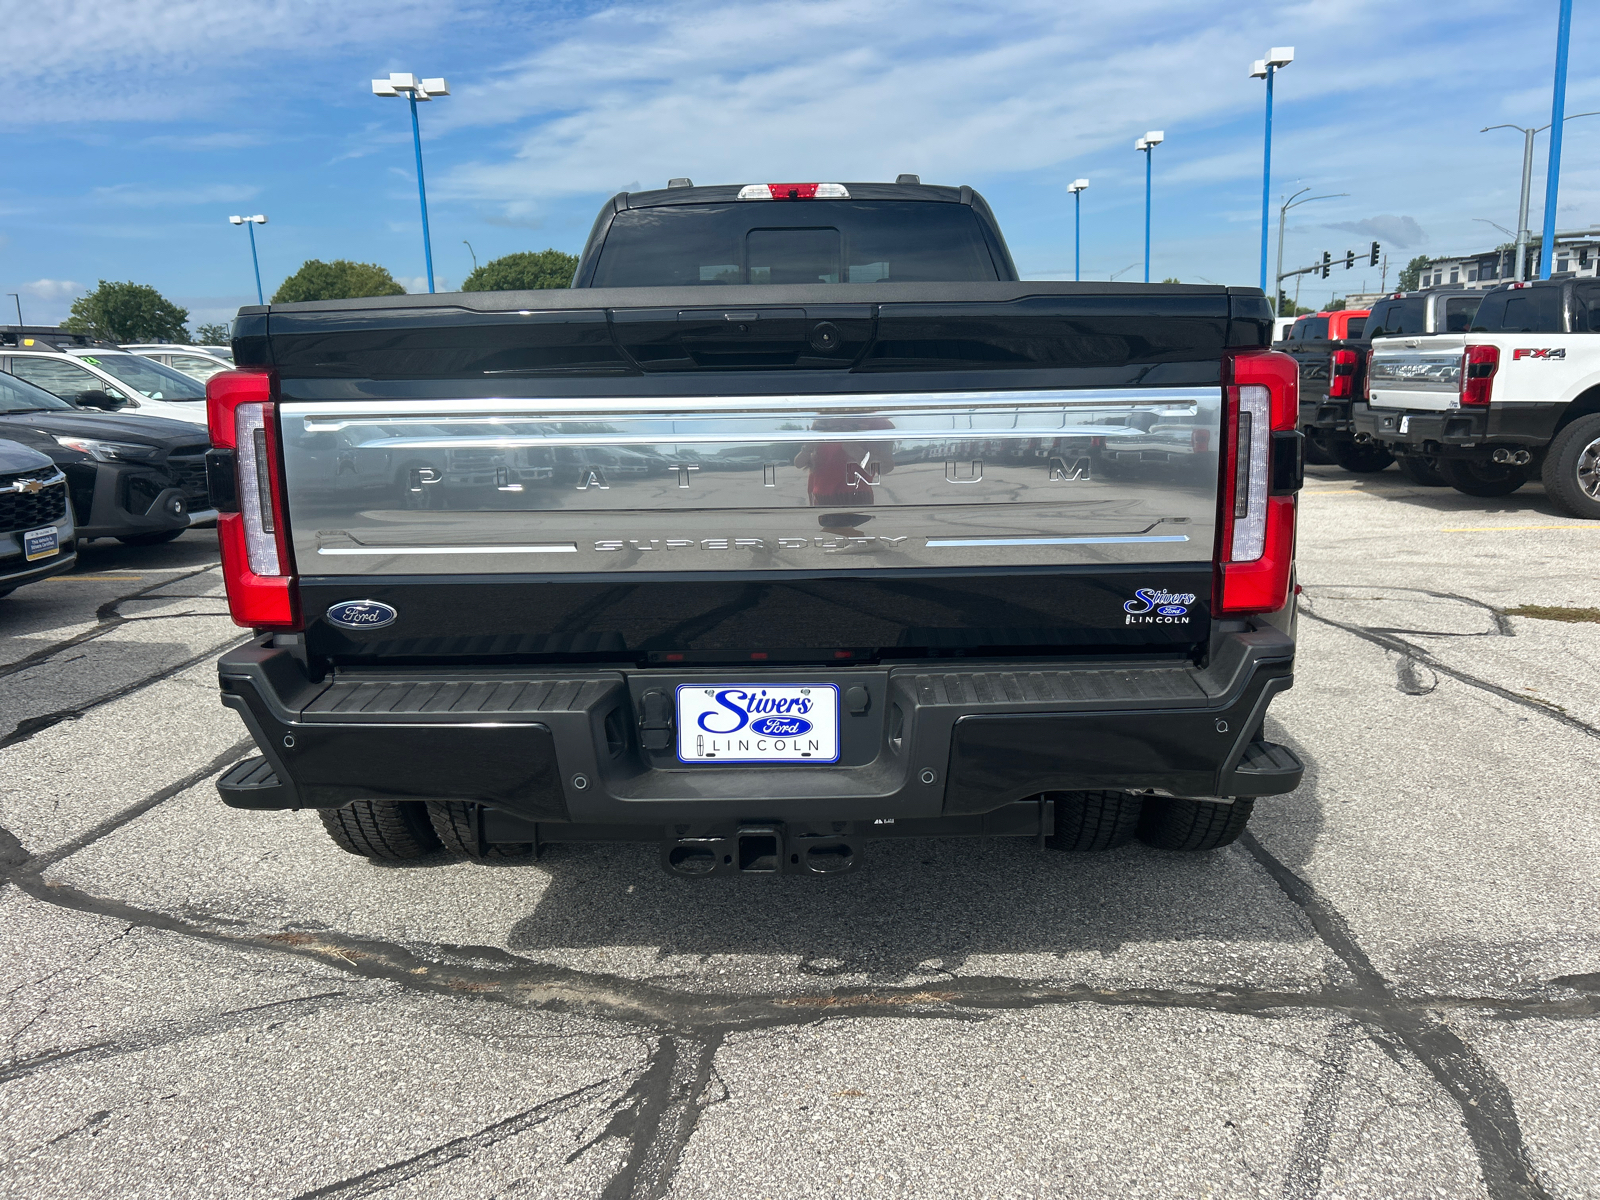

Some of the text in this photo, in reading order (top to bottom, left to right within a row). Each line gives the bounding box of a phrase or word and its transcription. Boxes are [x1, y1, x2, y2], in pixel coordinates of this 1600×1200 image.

[1513, 348, 1566, 361] FX4
[409, 456, 1092, 492] PLATINUM
[1123, 588, 1196, 614] Stivers
[342, 606, 380, 622] Ford
[1131, 616, 1189, 624] LINCOLN
[697, 689, 814, 734] Stivers
[762, 718, 799, 734] Ford
[713, 739, 819, 752] LINCOLN
